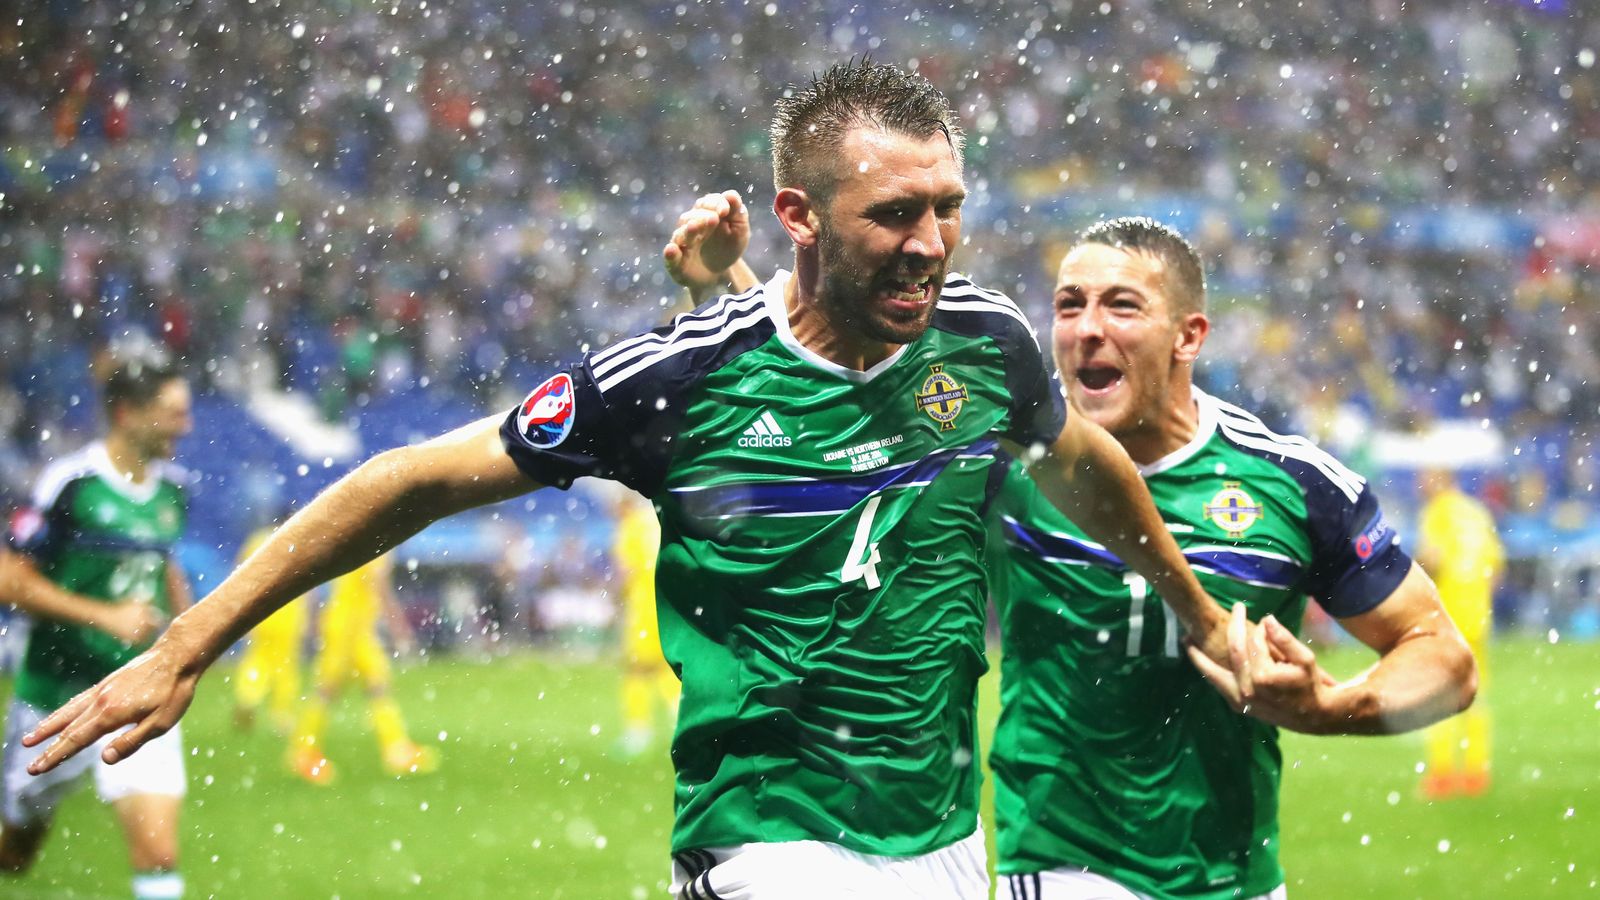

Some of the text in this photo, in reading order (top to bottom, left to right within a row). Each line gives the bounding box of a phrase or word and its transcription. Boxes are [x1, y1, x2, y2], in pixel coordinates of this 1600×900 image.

[923, 391, 962, 404] NORTHERN IRELAND
[737, 434, 792, 448] adidas
[823, 434, 904, 462] UKRAINE VS NORTHERN IRELAND
[857, 453, 870, 464] JUNE
[875, 455, 889, 467] LYON
[841, 495, 882, 590] 4
[1122, 571, 1179, 657] 11
